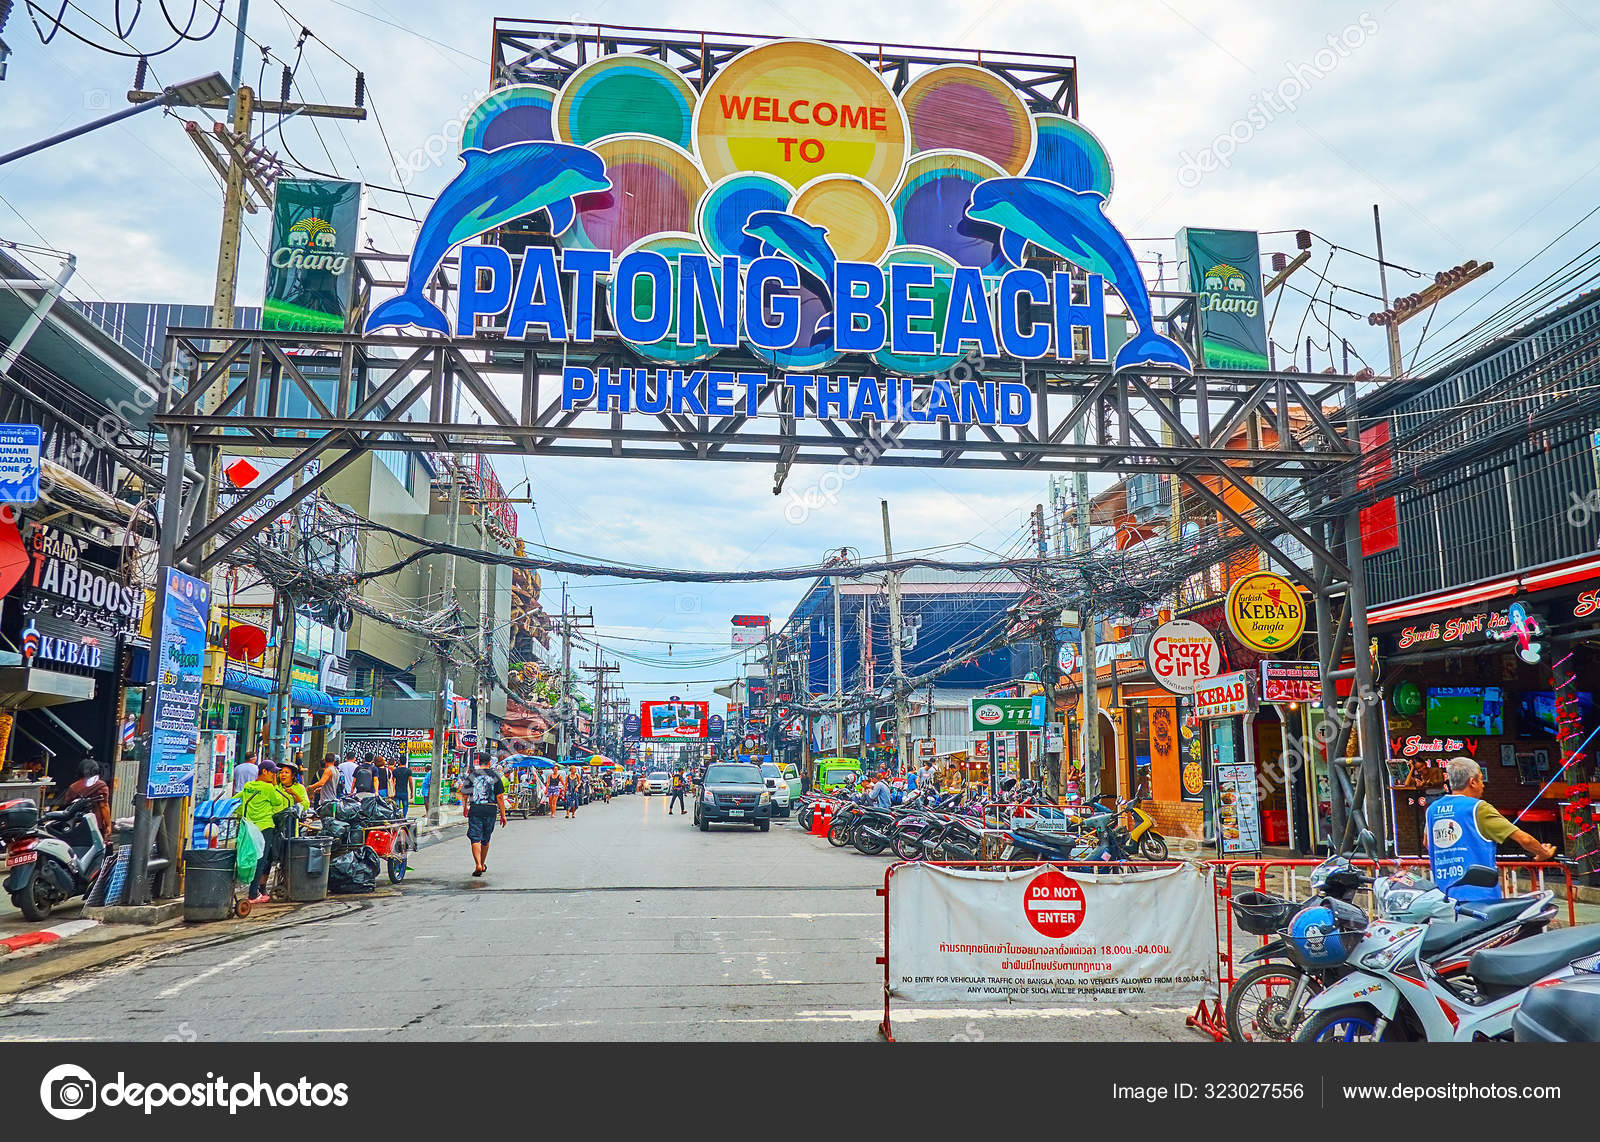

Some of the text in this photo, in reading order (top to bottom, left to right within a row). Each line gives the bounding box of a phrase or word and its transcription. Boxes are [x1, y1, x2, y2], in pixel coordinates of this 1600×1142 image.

[720, 95, 887, 131] WELCOME
[777, 137, 825, 163] TO
[272, 247, 349, 275] Chang
[455, 244, 1109, 363] PATONG BEACH
[1200, 292, 1259, 317] Chang
[562, 366, 1033, 427] PHUKET THAILAND
[0, 456, 32, 464] AZARD
[33, 533, 78, 562] GRAND
[32, 552, 146, 618] TARBOOSH
[1240, 601, 1299, 619] KEBAB
[1252, 621, 1285, 634] Bangla
[1443, 613, 1487, 641] Sport
[1488, 612, 1510, 629] Bar
[39, 635, 101, 668] KEBAB
[1153, 637, 1212, 664] Crazy
[1155, 656, 1211, 677] Girls
[1196, 683, 1245, 707] KEBAB
[338, 706, 369, 714] ARMACY
[391, 728, 424, 737] ibiza
[1444, 738, 1464, 752] Bar
[1437, 805, 1454, 814] TAXI
[1032, 886, 1078, 899] DO NOT
[1037, 912, 1076, 924] ENTER
[950, 976, 986, 984] VEHICULAR
[988, 977, 1013, 985] TRAFFIC
[1121, 977, 1152, 985] ALLOWED
[1077, 987, 1117, 995] PUNISHABLE
